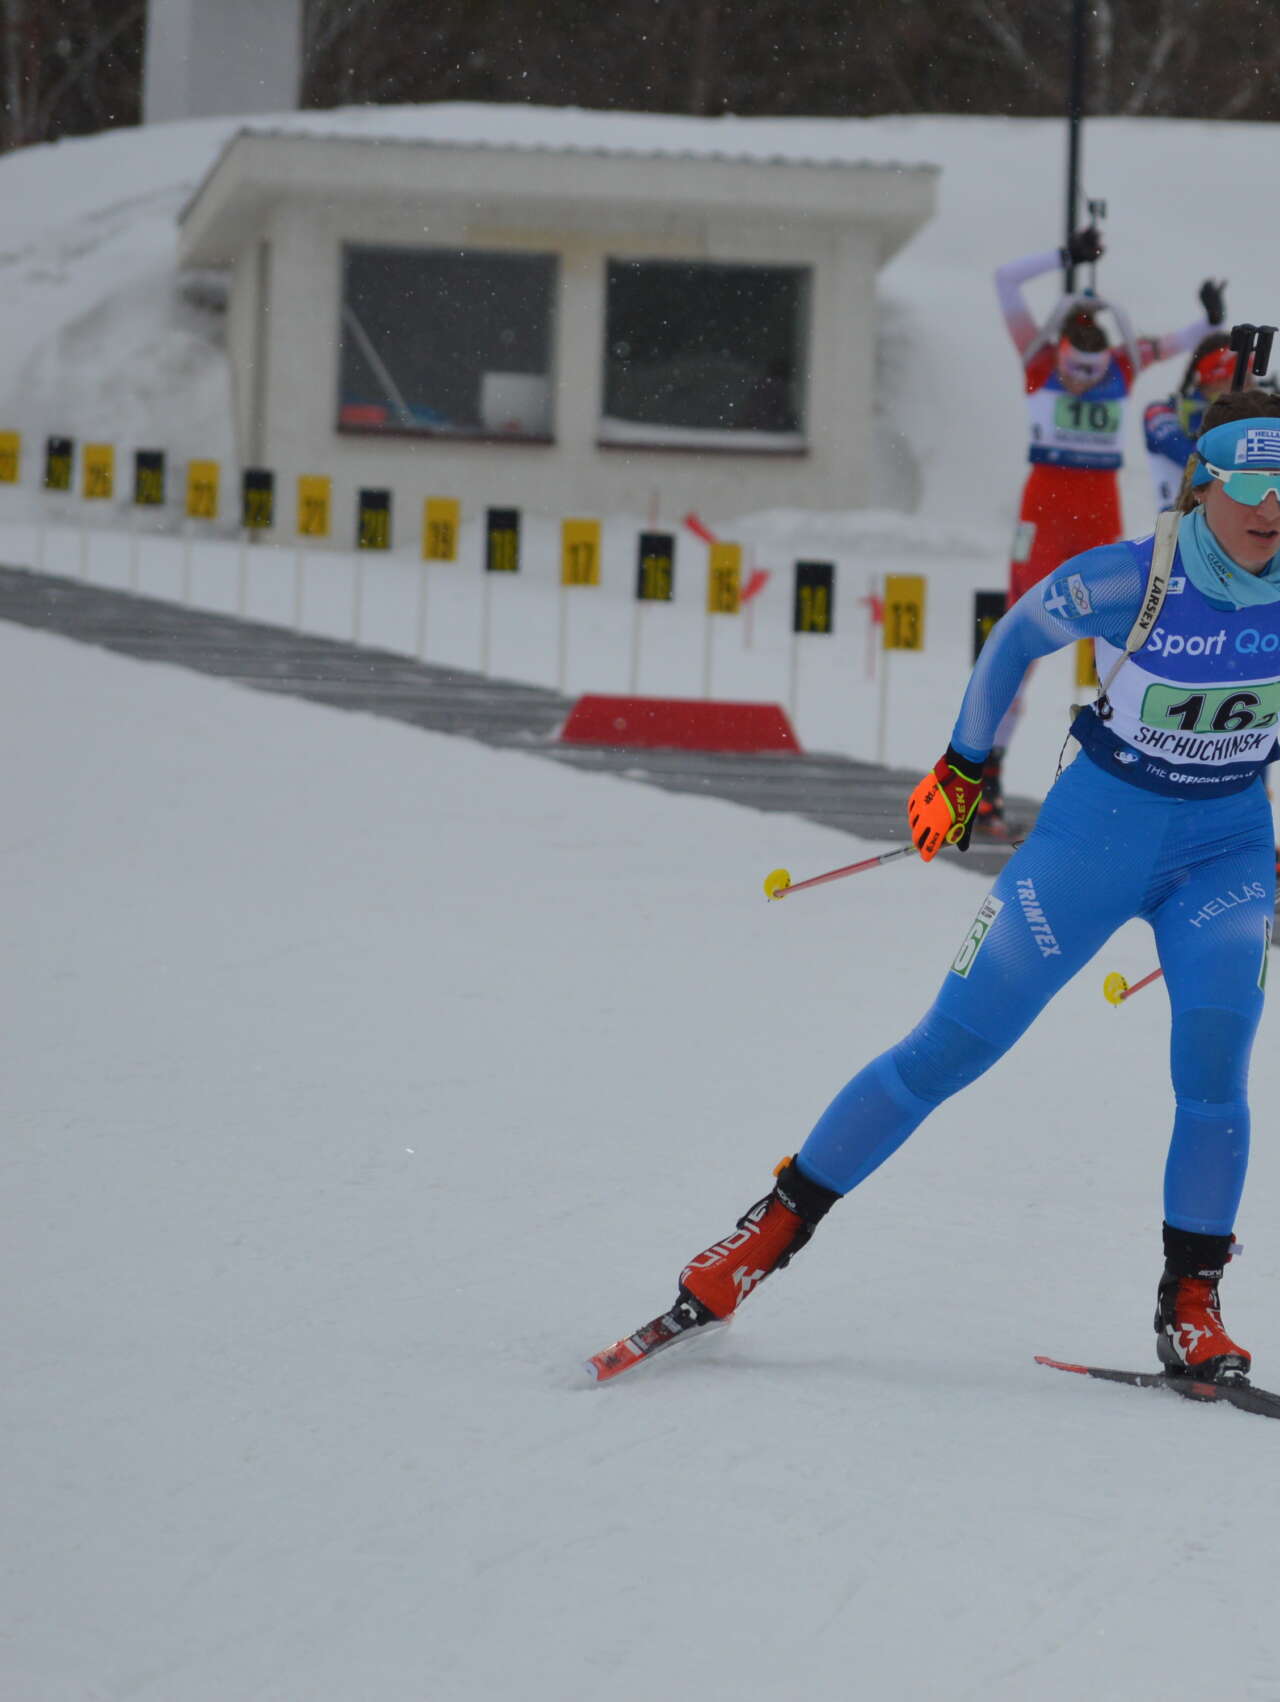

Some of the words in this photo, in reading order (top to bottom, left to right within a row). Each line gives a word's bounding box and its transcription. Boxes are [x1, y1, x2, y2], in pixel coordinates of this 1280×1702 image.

[569, 542, 595, 583] 17
[801, 585, 827, 632] 14
[1139, 576, 1165, 629] LARSEN
[891, 602, 918, 648] 13
[1147, 627, 1227, 657] Sport
[1167, 692, 1262, 731] 16
[1134, 727, 1270, 761] SHCHUCHINSK
[1146, 764, 1167, 778] THE
[954, 787, 967, 824] LEKI
[1016, 878, 1062, 958] TRIMTEX
[1189, 882, 1266, 929] HELLAS
